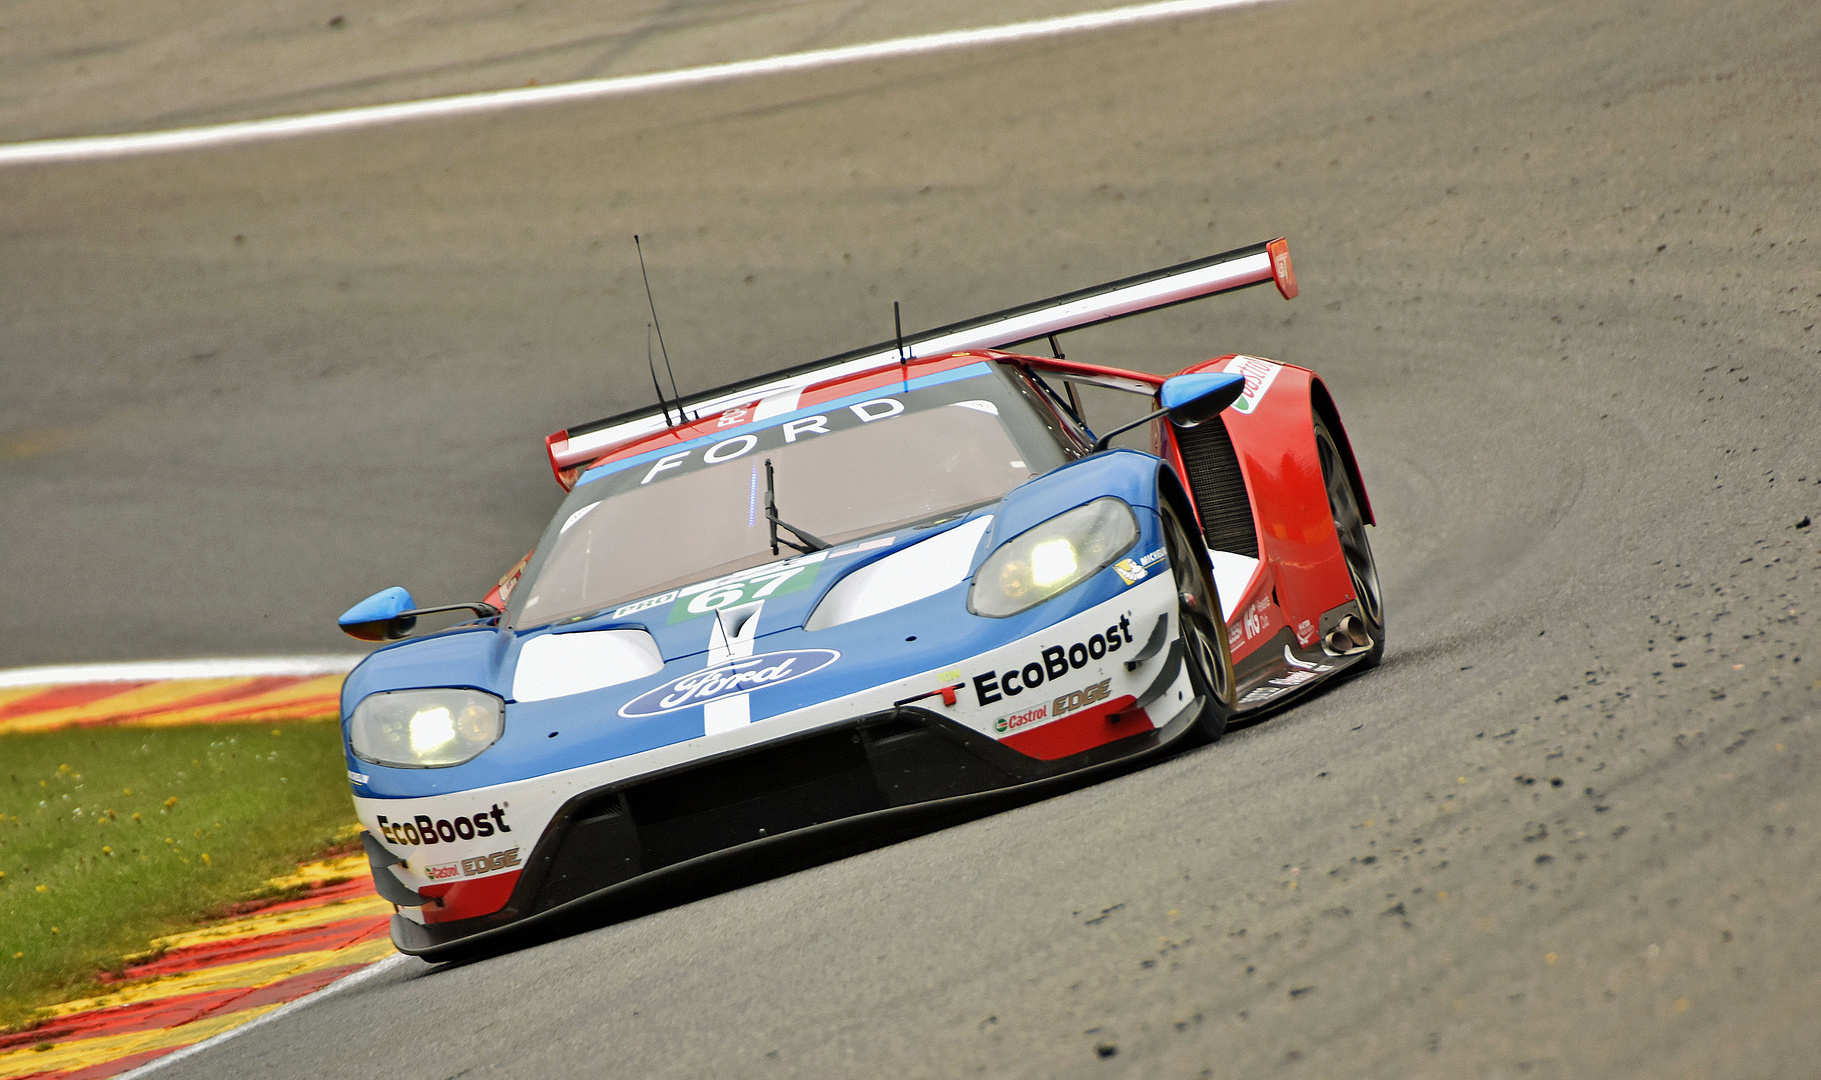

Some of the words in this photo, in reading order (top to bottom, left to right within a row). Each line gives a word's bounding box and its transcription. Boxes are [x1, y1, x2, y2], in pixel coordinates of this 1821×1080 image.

[641, 398, 905, 485] FORD
[616, 593, 676, 617] PRO
[687, 565, 805, 614] 67
[660, 656, 797, 709] Ford
[972, 614, 1134, 707] EcoBoost
[1008, 704, 1048, 729] Castrol
[1052, 677, 1112, 718] EDGE
[376, 802, 511, 846] EcoBoost
[461, 847, 522, 877] EDGE
